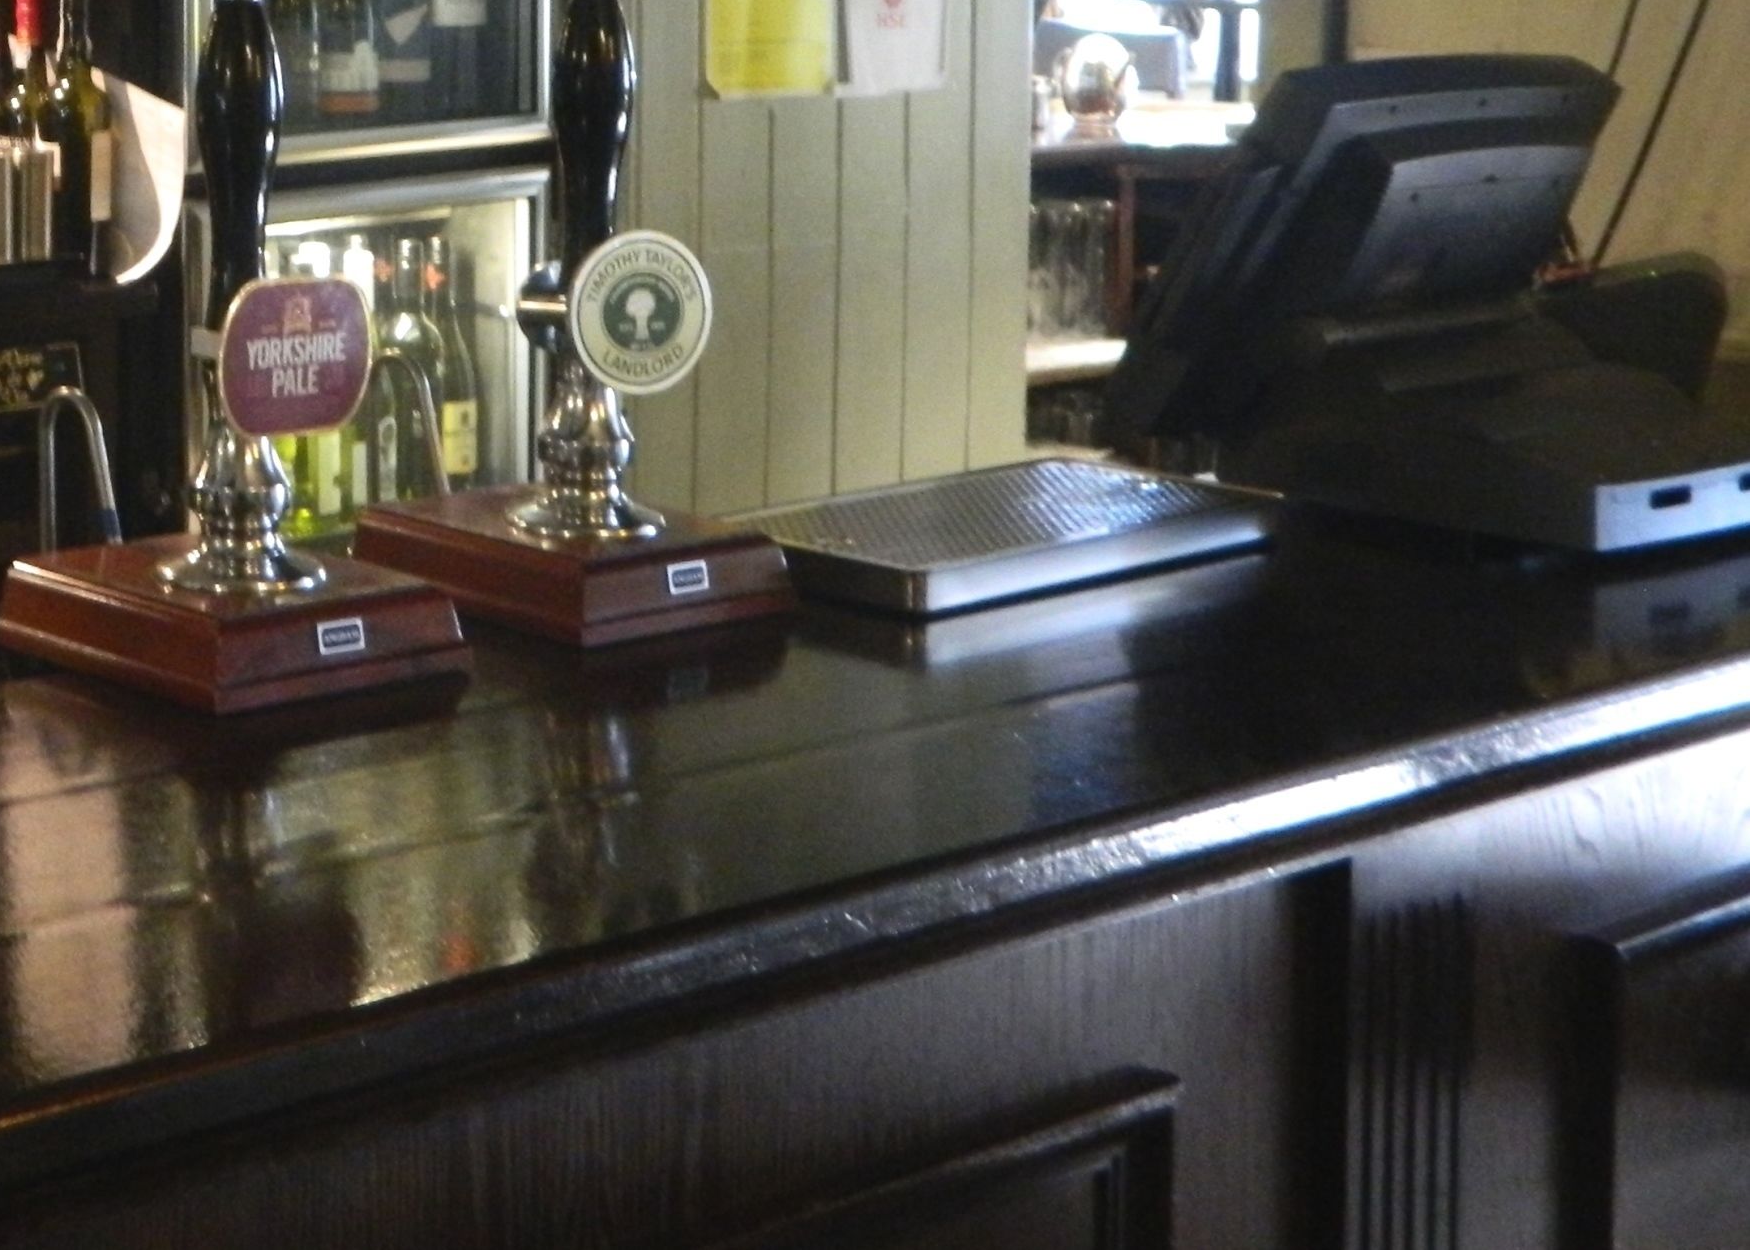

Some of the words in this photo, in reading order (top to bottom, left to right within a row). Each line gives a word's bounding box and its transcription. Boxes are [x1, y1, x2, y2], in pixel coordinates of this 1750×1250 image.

[587, 250, 641, 304] TIMOTHY
[246, 331, 347, 371] YORKSHIRE
[602, 345, 684, 378] LANDLORD
[271, 364, 320, 398] PALE
